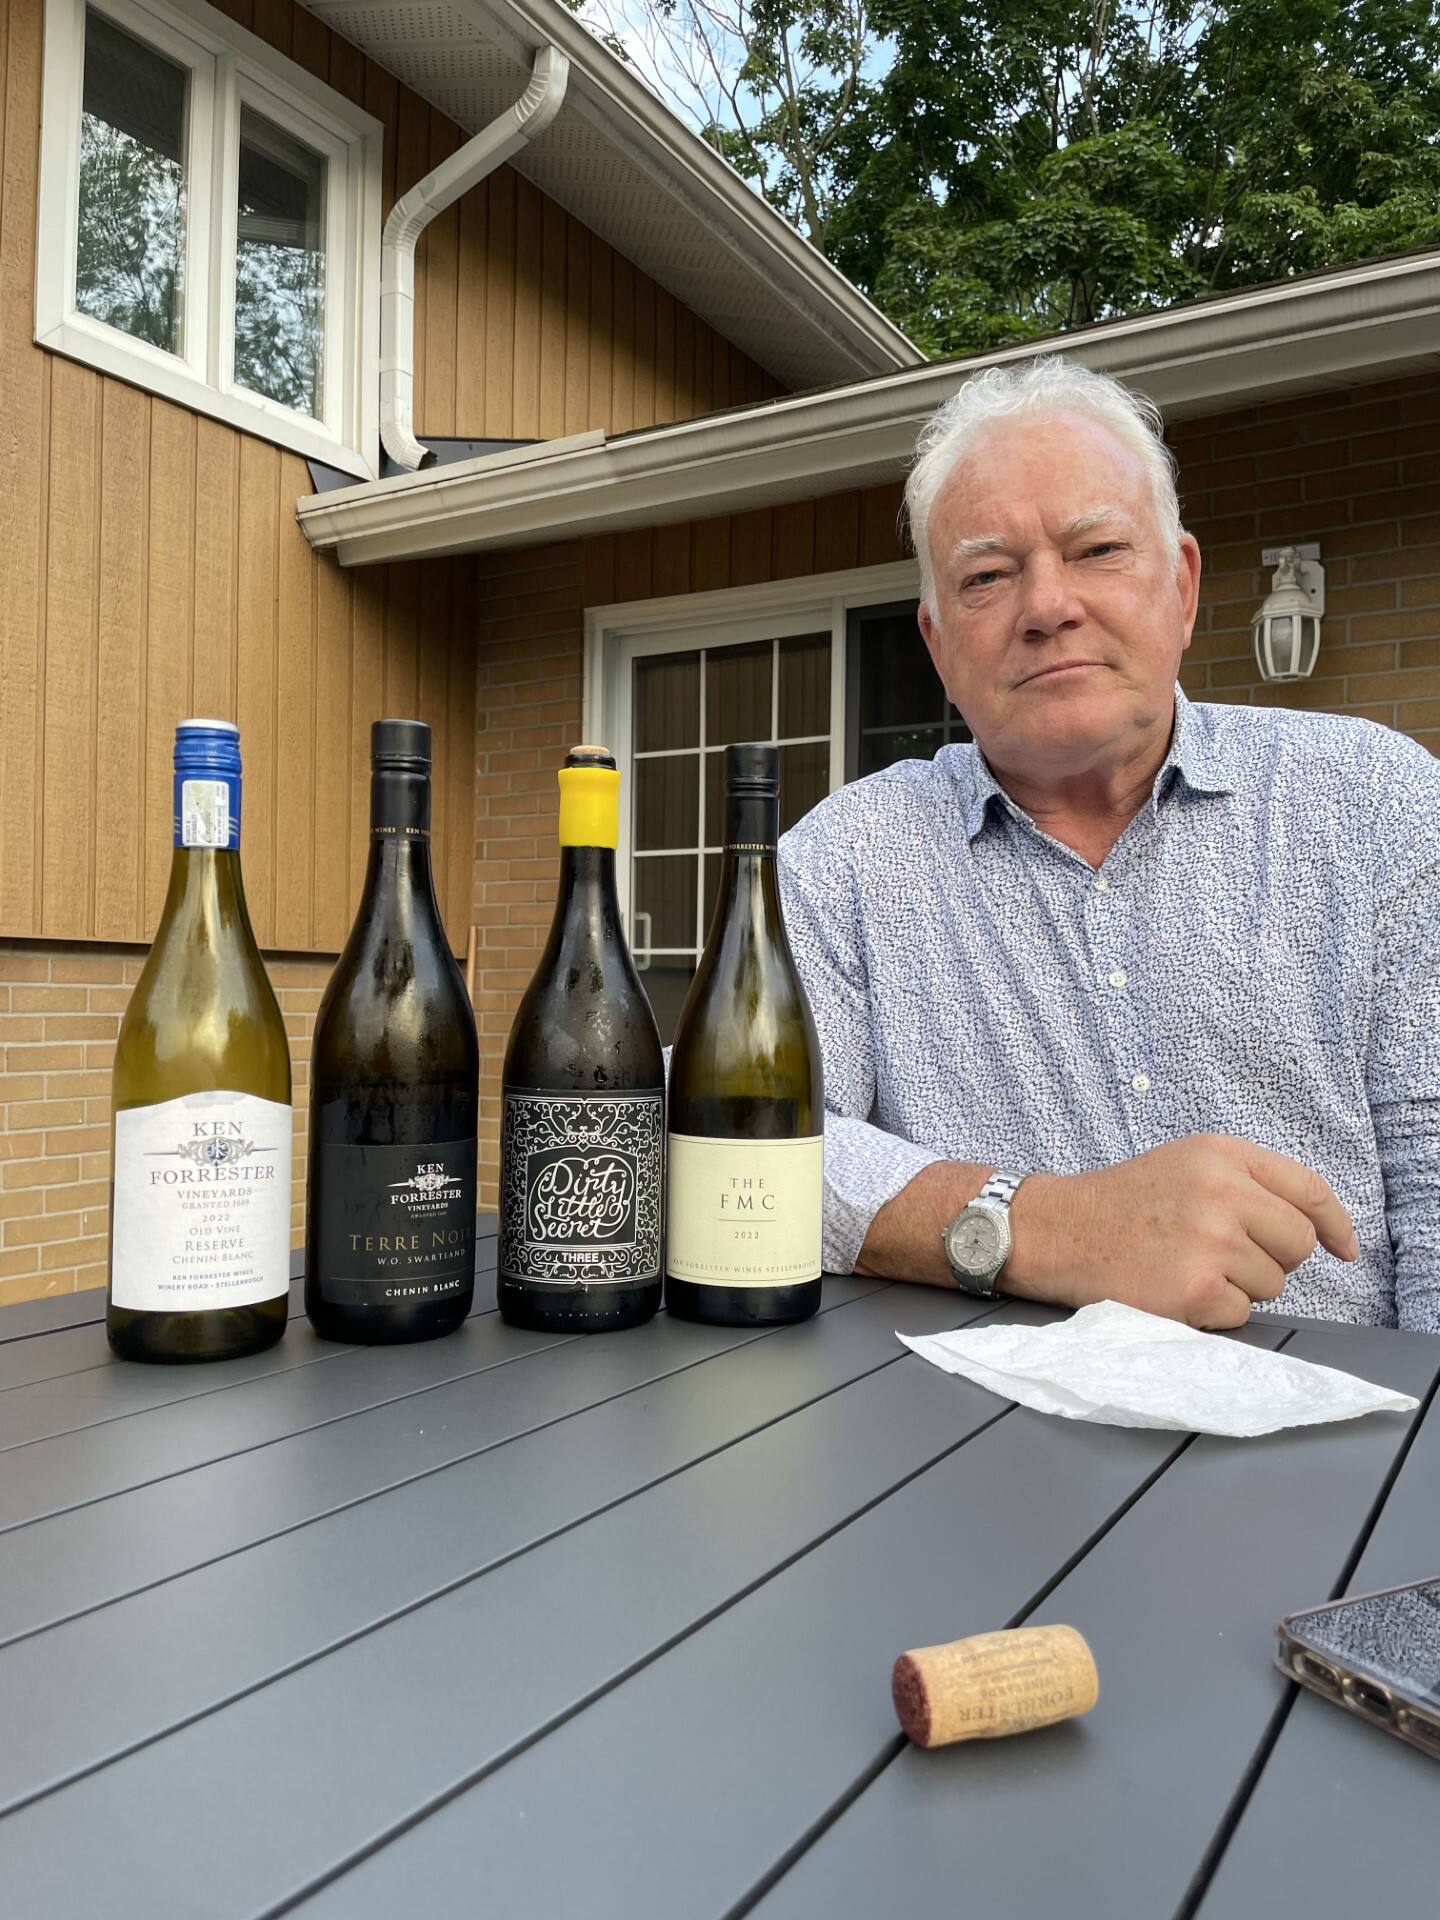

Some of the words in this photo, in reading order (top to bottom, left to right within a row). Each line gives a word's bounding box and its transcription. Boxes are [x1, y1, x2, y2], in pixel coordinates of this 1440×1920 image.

[192, 1121, 244, 1137] KEN
[150, 1165, 275, 1185] FORRESTER
[416, 1163, 444, 1174] KEN
[538, 1157, 628, 1200] Dirty
[730, 1177, 766, 1189] THE
[177, 1187, 252, 1199] VINEYARDS
[390, 1189, 462, 1205] FORRESTER
[182, 1201, 230, 1210] GRANTED
[407, 1202, 449, 1212] VINEYARDS
[543, 1194, 608, 1222] Little
[201, 1213, 231, 1223] 2022
[349, 1234, 420, 1251] TERRE
[432, 1227, 471, 1247] NOI
[734, 1231, 760, 1239] 2022
[407, 1248, 466, 1264] SWARTLAND
[561, 1252, 599, 1263] THREE
[385, 1286, 429, 1297] CHENIN
[433, 1280, 460, 1292] BLANC
[959, 1687, 1074, 1721] FORRESTER
